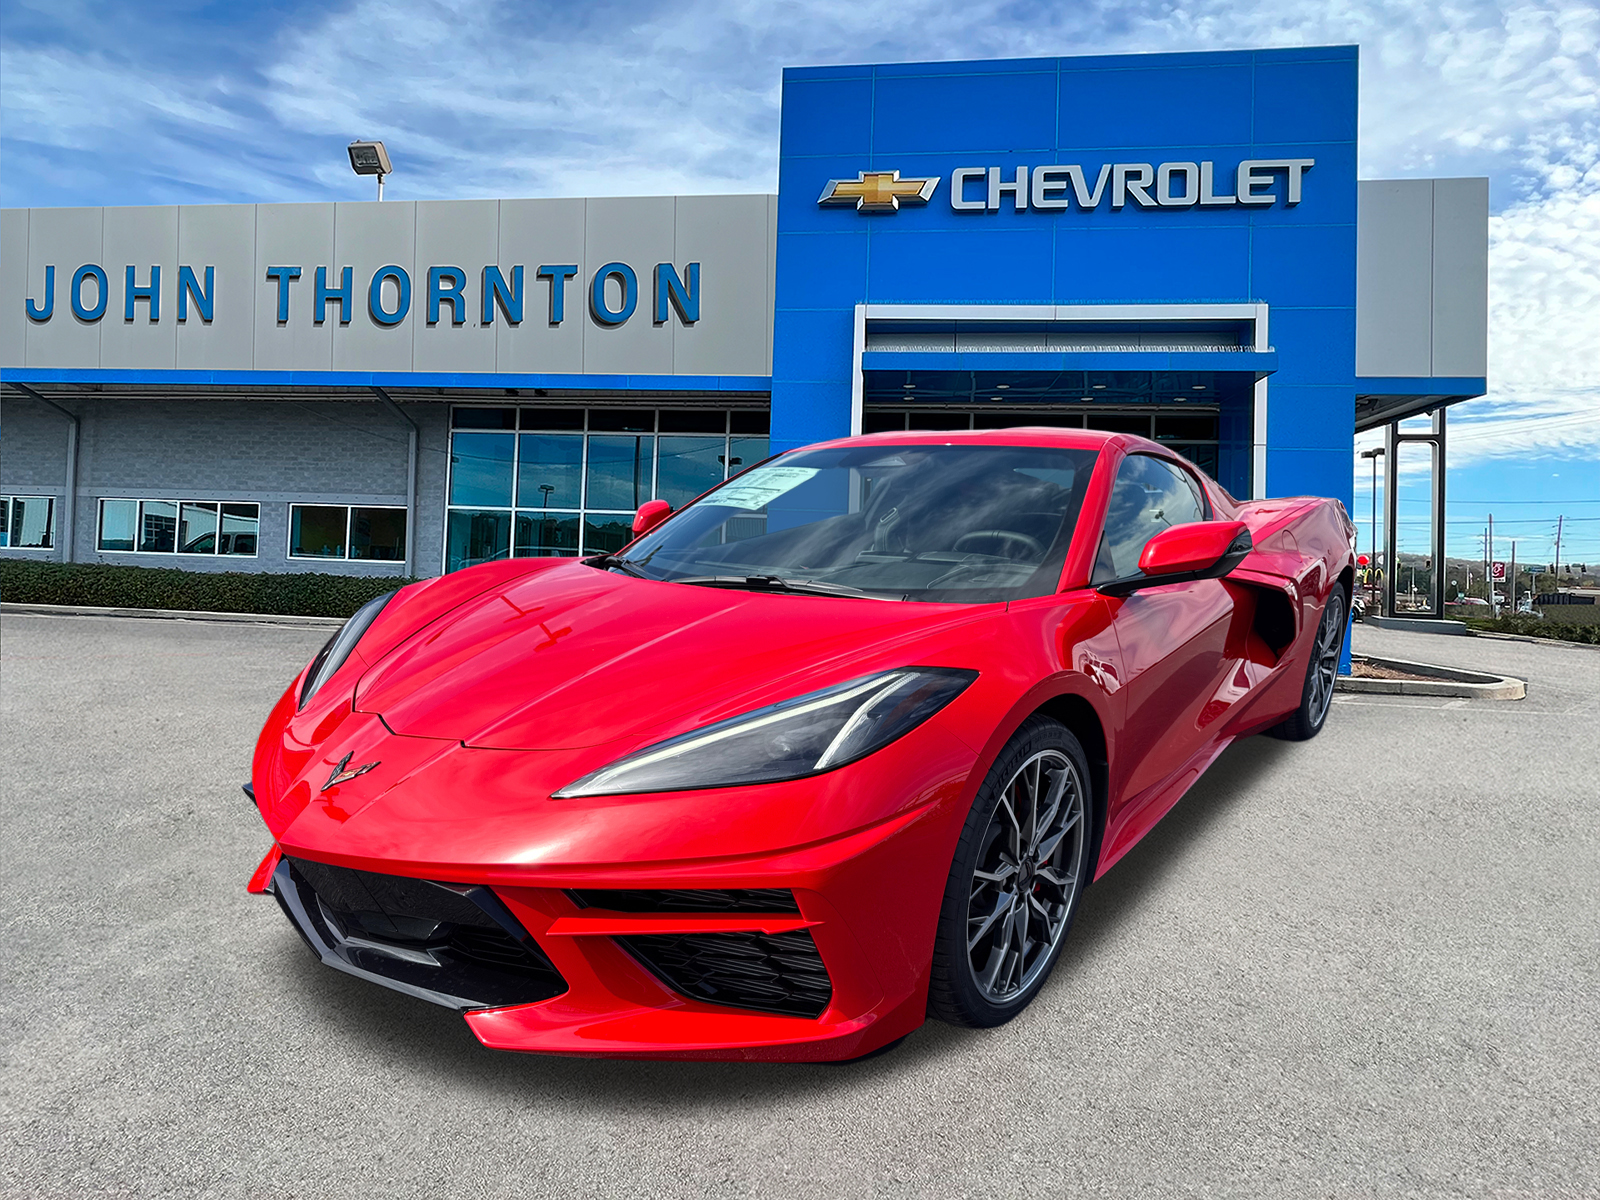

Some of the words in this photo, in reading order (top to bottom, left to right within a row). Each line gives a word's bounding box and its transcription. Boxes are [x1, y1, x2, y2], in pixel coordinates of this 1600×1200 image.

[950, 158, 1315, 211] CHEVROLET
[25, 264, 216, 322] JOHN
[266, 262, 701, 326] THORNTON
[992, 741, 1032, 797] MICHELIN
